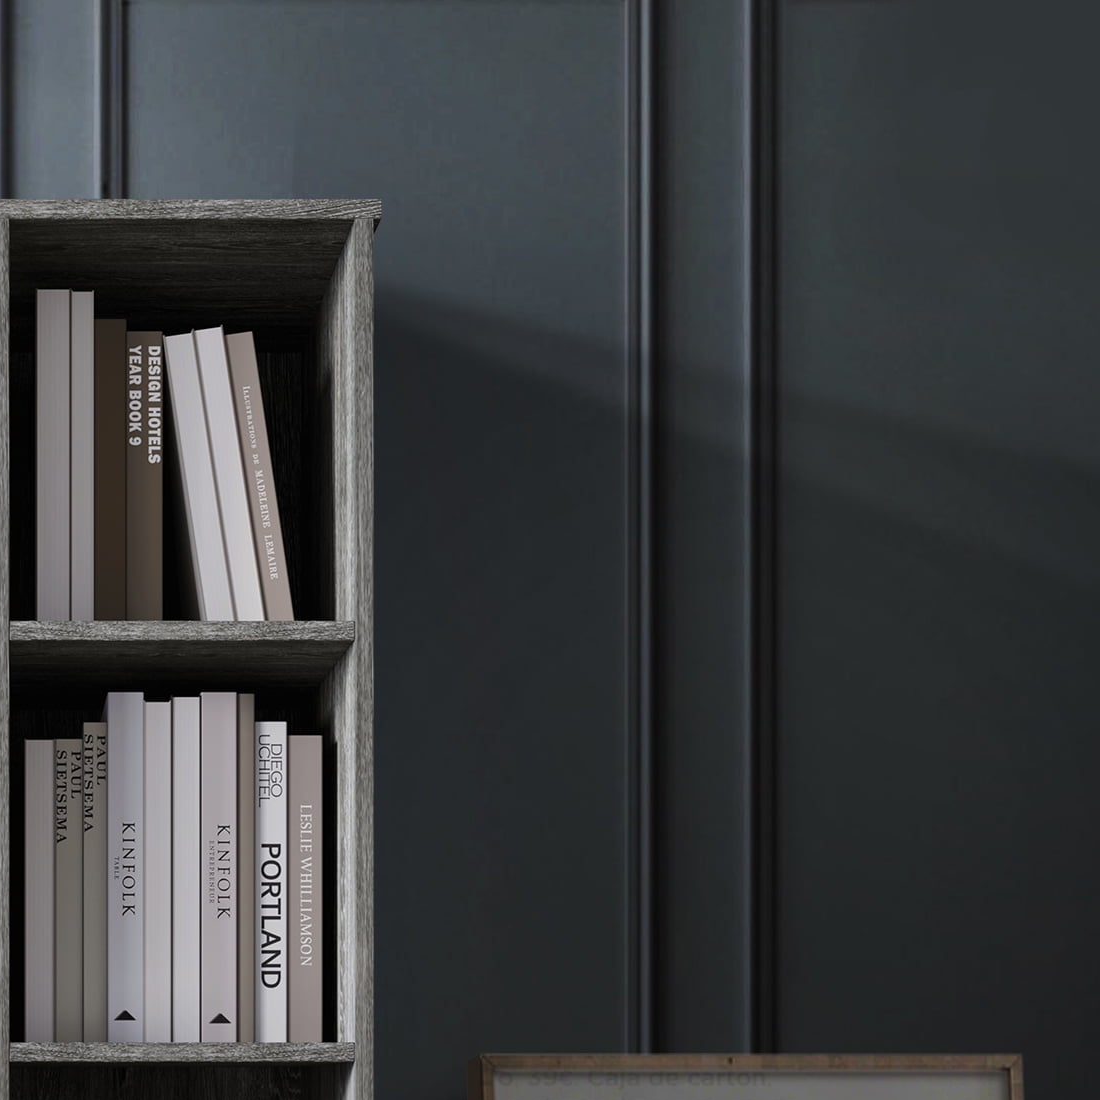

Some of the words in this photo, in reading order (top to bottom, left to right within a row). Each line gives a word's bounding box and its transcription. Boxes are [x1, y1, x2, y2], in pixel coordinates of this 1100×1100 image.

[128, 345, 142, 385] YEAR
[148, 345, 162, 402] DESIGN
[128, 389, 142, 432] BOOK
[148, 407, 162, 464] HOTELS
[128, 436, 142, 446] 9
[255, 470, 271, 529] MADELEINE
[264, 535, 279, 580] LEMAIRE
[70, 750, 82, 800] PAUL
[83, 734, 94, 833] SIETSEMA
[96, 734, 106, 786] PAUL
[258, 734, 271, 808] UCHITEL
[270, 743, 283, 798] DIEGO
[56, 749, 68, 844] SIETSEMA
[300, 804, 312, 853] LESLIE
[121, 822, 136, 917] KINFOLK
[217, 824, 231, 920] KINFOLK
[261, 843, 282, 989] PORTLAND
[300, 856, 312, 967] WHILLIAMSON
